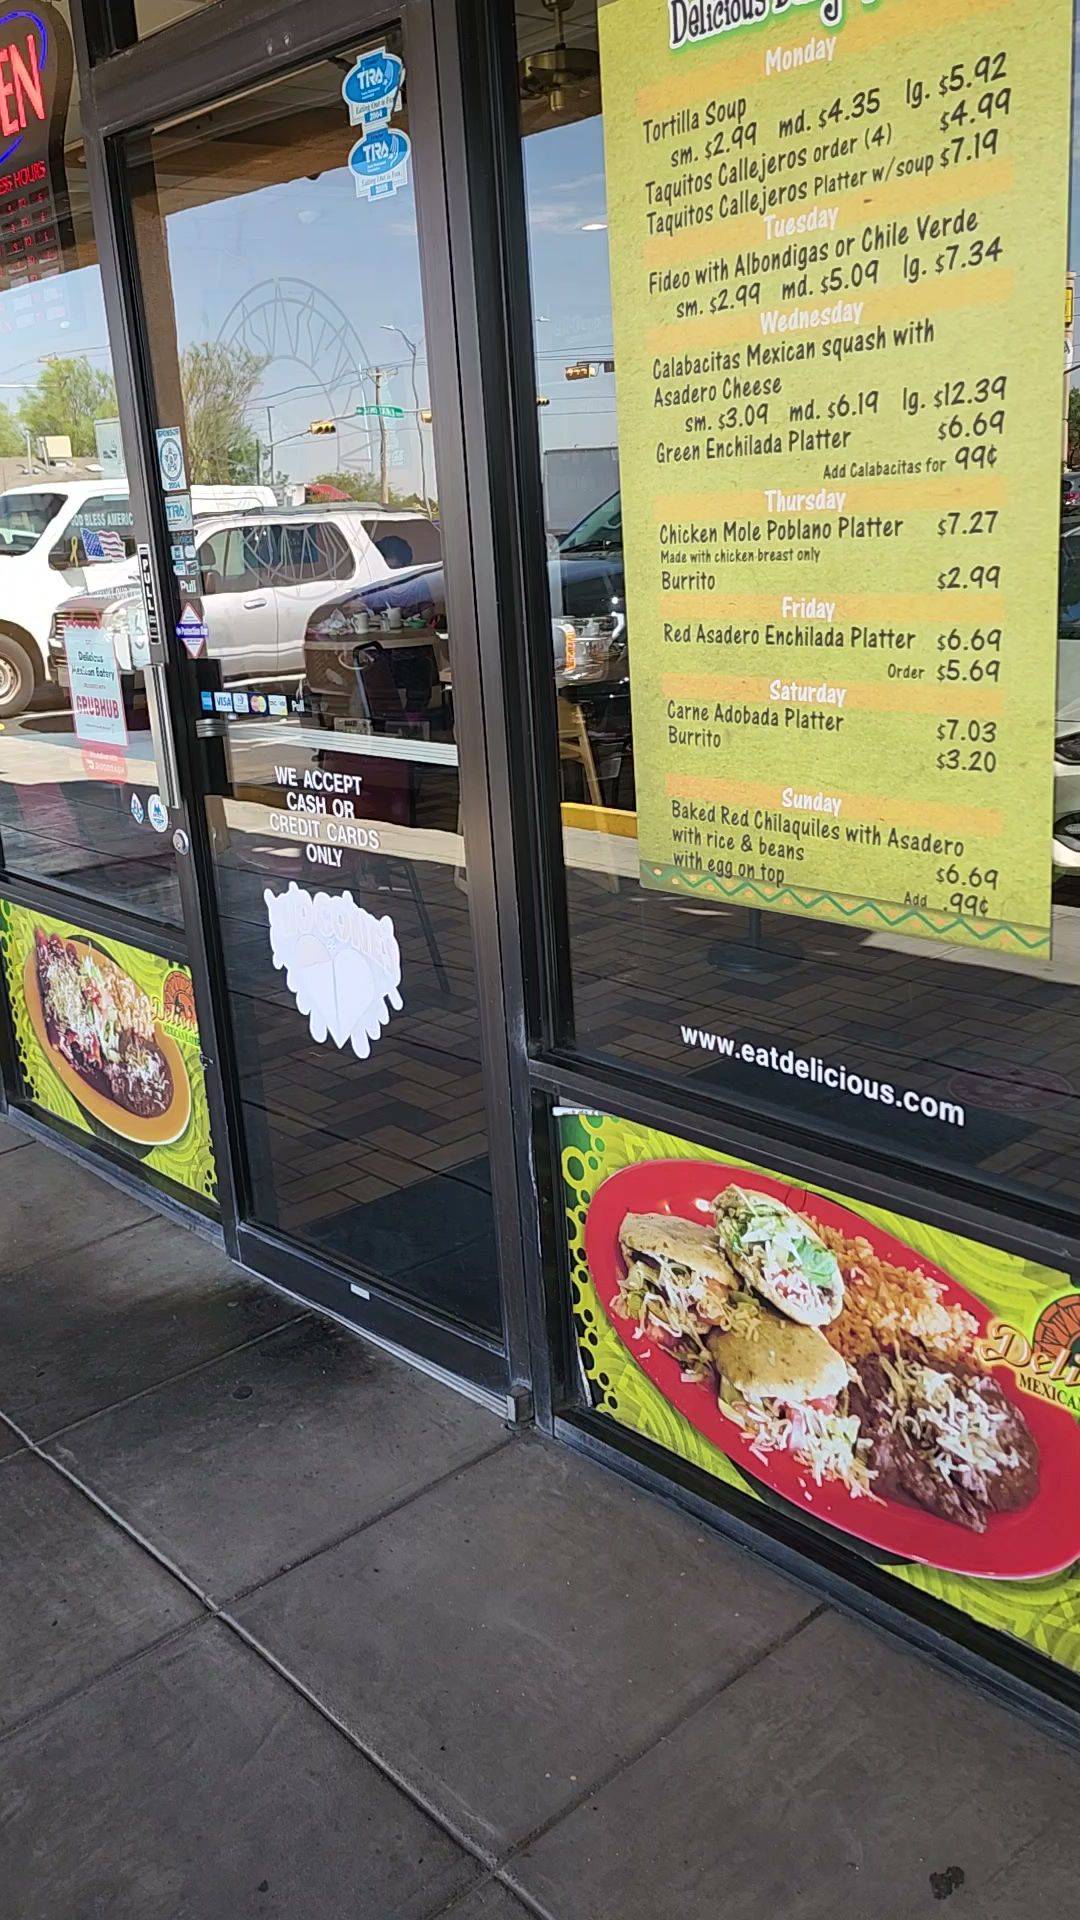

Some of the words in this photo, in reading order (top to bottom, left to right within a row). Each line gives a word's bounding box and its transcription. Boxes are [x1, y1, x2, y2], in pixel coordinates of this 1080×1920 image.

[765, 35, 836, 76] Monday
[643, 109, 700, 144] Tortilla
[706, 98, 747, 126] Soup
[671, 144, 699, 167] sm.
[705, 123, 757, 160] $2.99
[779, 116, 812, 139] md.
[819, 88, 880, 128] $4.35
[906, 78, 930, 108] lg.
[939, 52, 1007, 96] $5.92
[646, 168, 713, 205] Taquitos
[718, 151, 807, 188] Callejeros
[813, 136, 857, 163] order
[865, 123, 892, 150] (4)
[940, 88, 1011, 131] $4.99
[647, 203, 713, 237] Taquitos
[719, 184, 808, 220] Callejeros
[814, 170, 866, 195] Platter
[872, 153, 934, 183] w/soup
[940, 129, 998, 168] $7.19
[764, 205, 839, 240] Tuesday
[649, 270, 690, 294] Fideo
[695, 255, 729, 281] with
[735, 242, 828, 278] Albondigas
[835, 237, 855, 257] or
[861, 222, 909, 250] Chile
[917, 208, 978, 239] Verde
[677, 299, 704, 319] sm.
[710, 283, 760, 313] $2.99
[782, 276, 814, 300] md.
[821, 260, 878, 294] $5.09
[904, 255, 927, 281] lg.
[935, 237, 1002, 274] $7.34
[760, 301, 864, 335] Wednesday
[652, 350, 740, 380] Calabacitas
[747, 340, 815, 368] Mexican
[822, 325, 886, 362] squash
[894, 318, 934, 347] with
[654, 386, 717, 408] Asadero
[722, 377, 782, 399] Cheese
[685, 414, 712, 432] sm.
[718, 404, 768, 430] $3.09
[789, 401, 820, 421] md.
[828, 391, 878, 418] $6.19
[903, 386, 926, 416] lg.
[933, 376, 1007, 408] $12.39
[657, 444, 700, 463] Green
[706, 435, 782, 459] Enchilada
[789, 428, 851, 452] Platter
[938, 410, 1005, 440] $6.69
[823, 464, 845, 480] Add
[850, 459, 922, 478] Calabacitas
[926, 457, 946, 472] for
[954, 445, 998, 470] 99¢
[84, 512, 106, 526] BLESS
[107, 511, 134, 526] AMERIC
[765, 489, 846, 513] Thursday
[660, 524, 717, 545] Chicken
[723, 520, 761, 542] Mole
[767, 519, 832, 539] Poblano
[839, 517, 904, 537] Platter
[937, 511, 998, 535] $7.27
[660, 550, 686, 563] Made
[690, 550, 712, 562] with
[715, 549, 754, 562] chicken
[758, 549, 793, 561] breast
[797, 548, 820, 563] only
[142, 558, 155, 611] PULL
[180, 580, 197, 592] Pull
[662, 571, 715, 591] Burrito
[936, 566, 1000, 591] $2.99
[781, 597, 835, 621] Friday
[664, 624, 691, 643] Red
[696, 625, 759, 645] Asadero
[765, 625, 844, 647] Enchilada
[851, 628, 916, 649] Platter
[937, 629, 1002, 652] $6.69
[887, 663, 925, 680] Order
[936, 659, 1000, 682] $5.69
[76, 695, 120, 719] GRUBHUB
[217, 696, 231, 706] VISA
[770, 679, 846, 707] Saturday
[667, 700, 709, 721] Carne
[714, 705, 780, 727] Adobada
[785, 708, 843, 732] Platter
[936, 719, 997, 743] $7.03
[668, 726, 721, 749] Burrito
[936, 750, 996, 773] $3.20
[274, 766, 298, 786] WE
[303, 770, 362, 795] ACCEPT
[286, 791, 326, 815] CASH
[332, 798, 355, 819] OR
[782, 788, 842, 817] Sunday
[270, 813, 320, 838] CREDIT
[326, 823, 379, 849] CARDS
[672, 801, 716, 824] Baked
[721, 806, 749, 827] Red
[754, 812, 840, 840] Chilaquiles
[846, 824, 882, 846] with
[888, 829, 964, 857] Asadero
[672, 826, 701, 845] with
[706, 830, 735, 849] rice
[740, 834, 752, 852] &
[759, 838, 804, 861] beans
[306, 844, 342, 867] ONLY
[673, 851, 702, 870] with
[707, 857, 733, 879] egg
[739, 864, 755, 880] on
[760, 865, 784, 887] top
[936, 866, 998, 890] $6.69
[904, 892, 927, 908] Add
[943, 893, 989, 915] .99¢
[680, 1025, 966, 1127] www.eatdelicious.com
[1019, 1372, 1080, 1412] MEXICA
